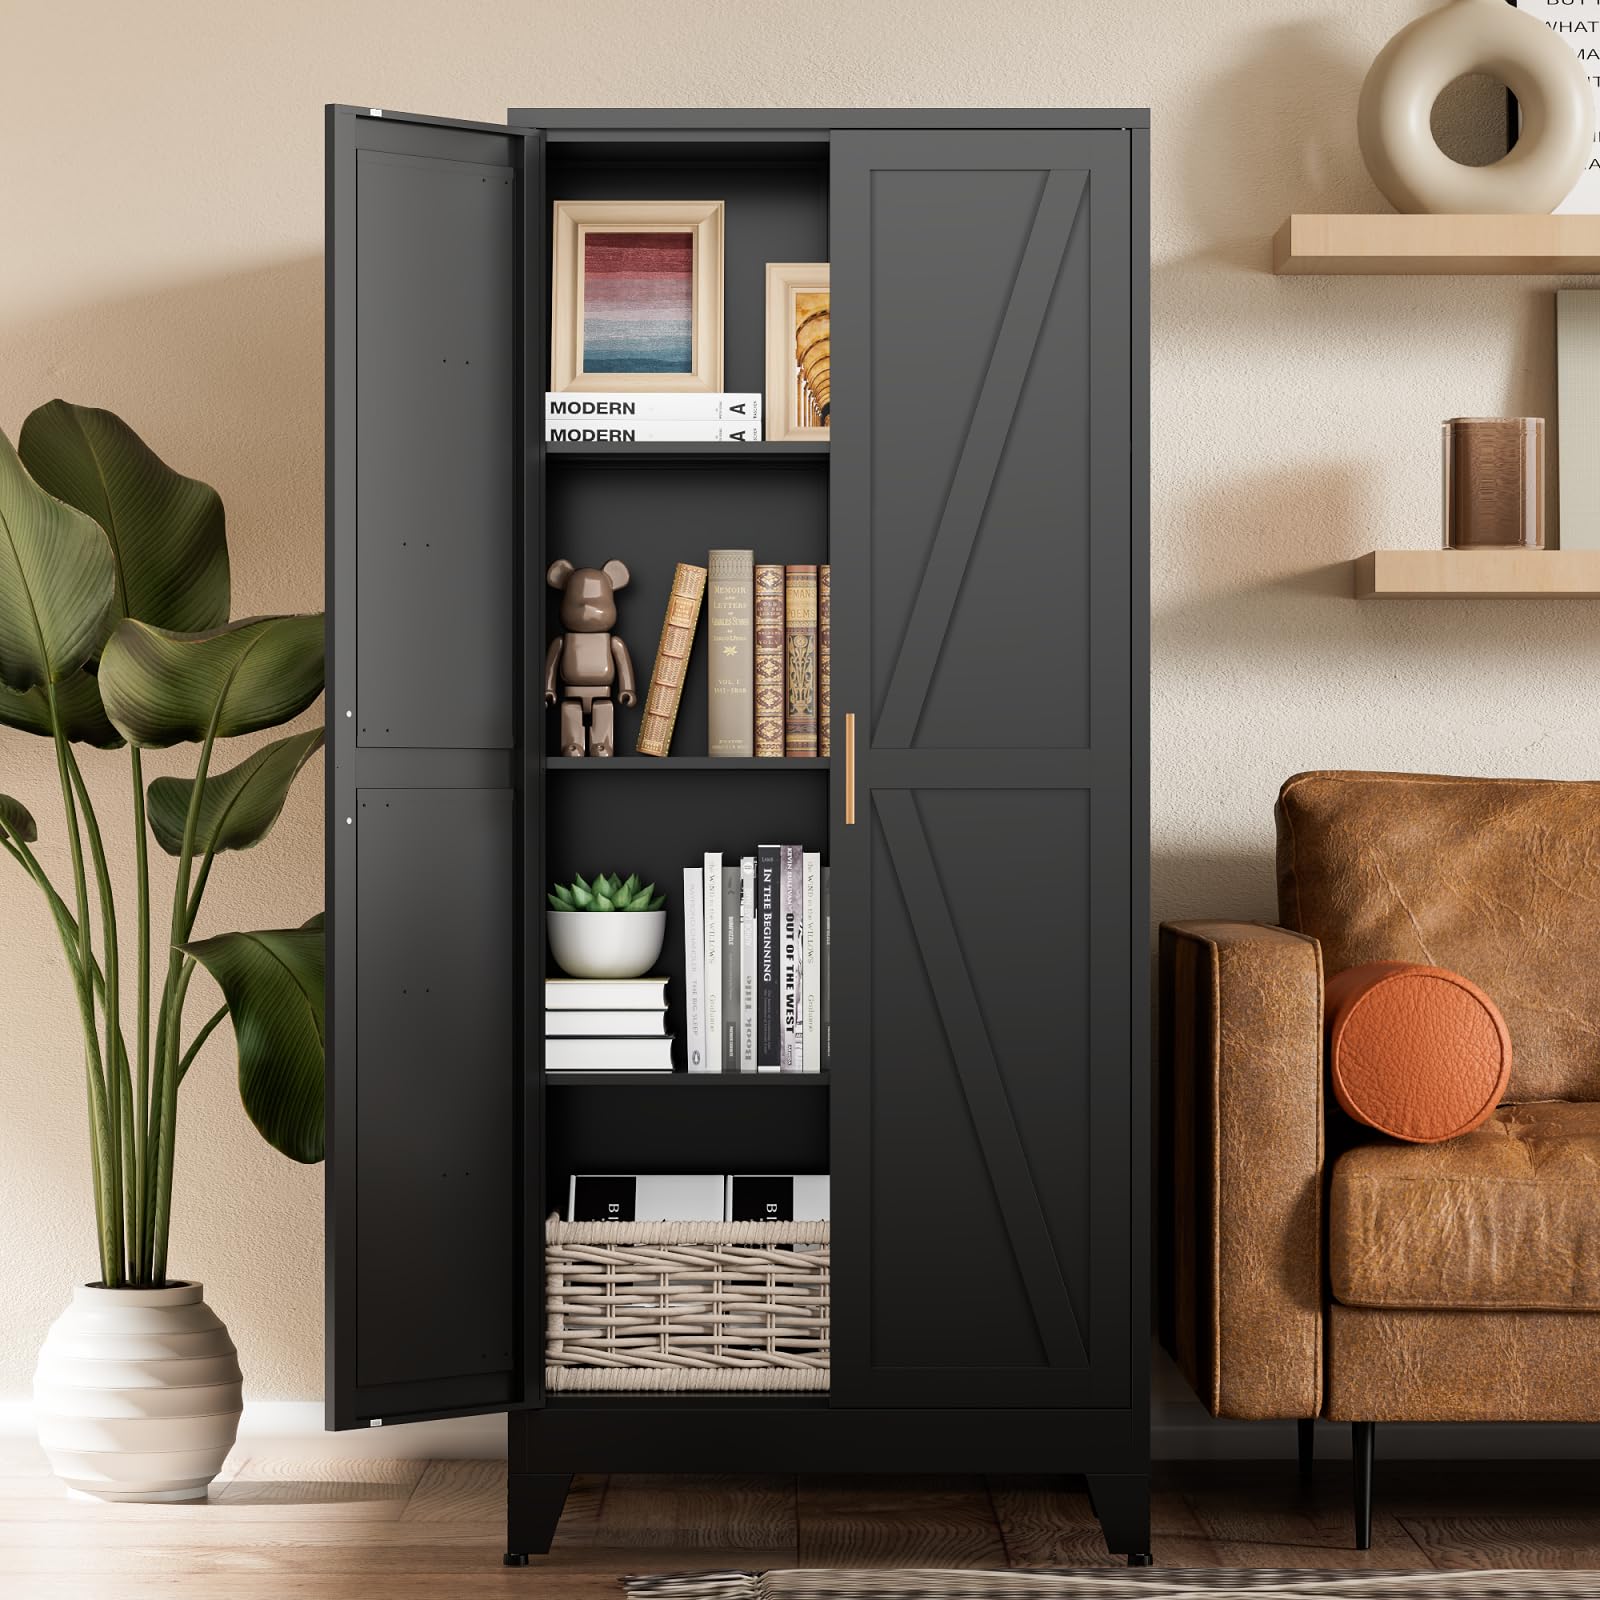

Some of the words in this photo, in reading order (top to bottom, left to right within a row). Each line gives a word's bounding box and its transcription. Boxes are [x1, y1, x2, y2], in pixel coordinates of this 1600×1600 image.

[550, 401, 636, 415] MODERN
[729, 402, 746, 416] A
[550, 428, 636, 442] MODERN
[729, 430, 746, 442] A
[763, 868, 773, 882] IN
[763, 886, 772, 910] THE
[785, 912, 795, 940] OUT
[763, 912, 772, 982] BEGINNING
[785, 944, 795, 960] OF
[785, 964, 795, 990] THE
[785, 993, 795, 1034] WEST
